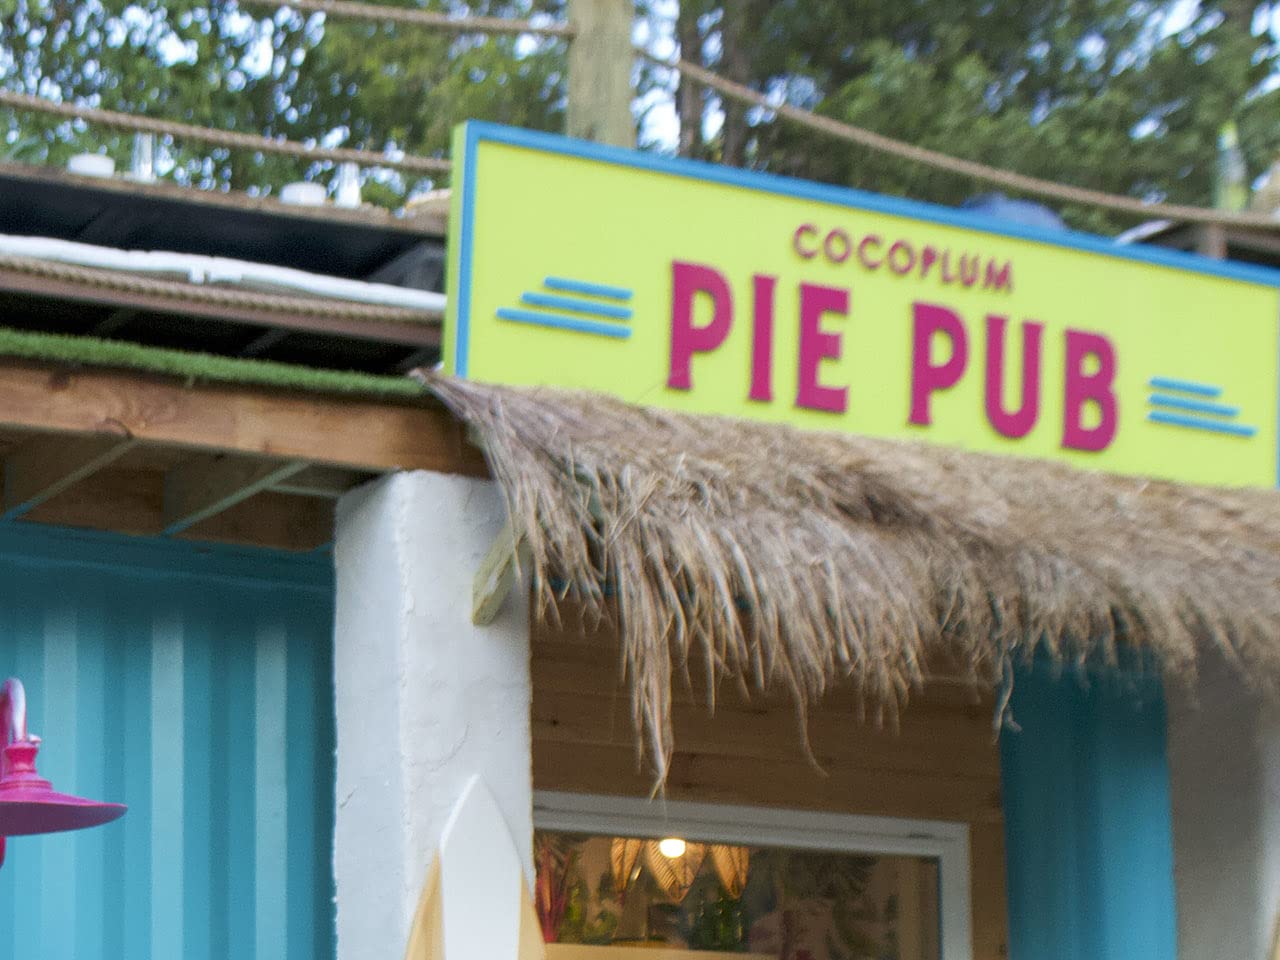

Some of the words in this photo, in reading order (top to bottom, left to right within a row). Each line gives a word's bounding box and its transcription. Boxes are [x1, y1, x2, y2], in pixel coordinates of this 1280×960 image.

[792, 222, 1013, 290] COCOPLUM
[666, 258, 852, 414] PIE
[906, 299, 1121, 453] PUB
